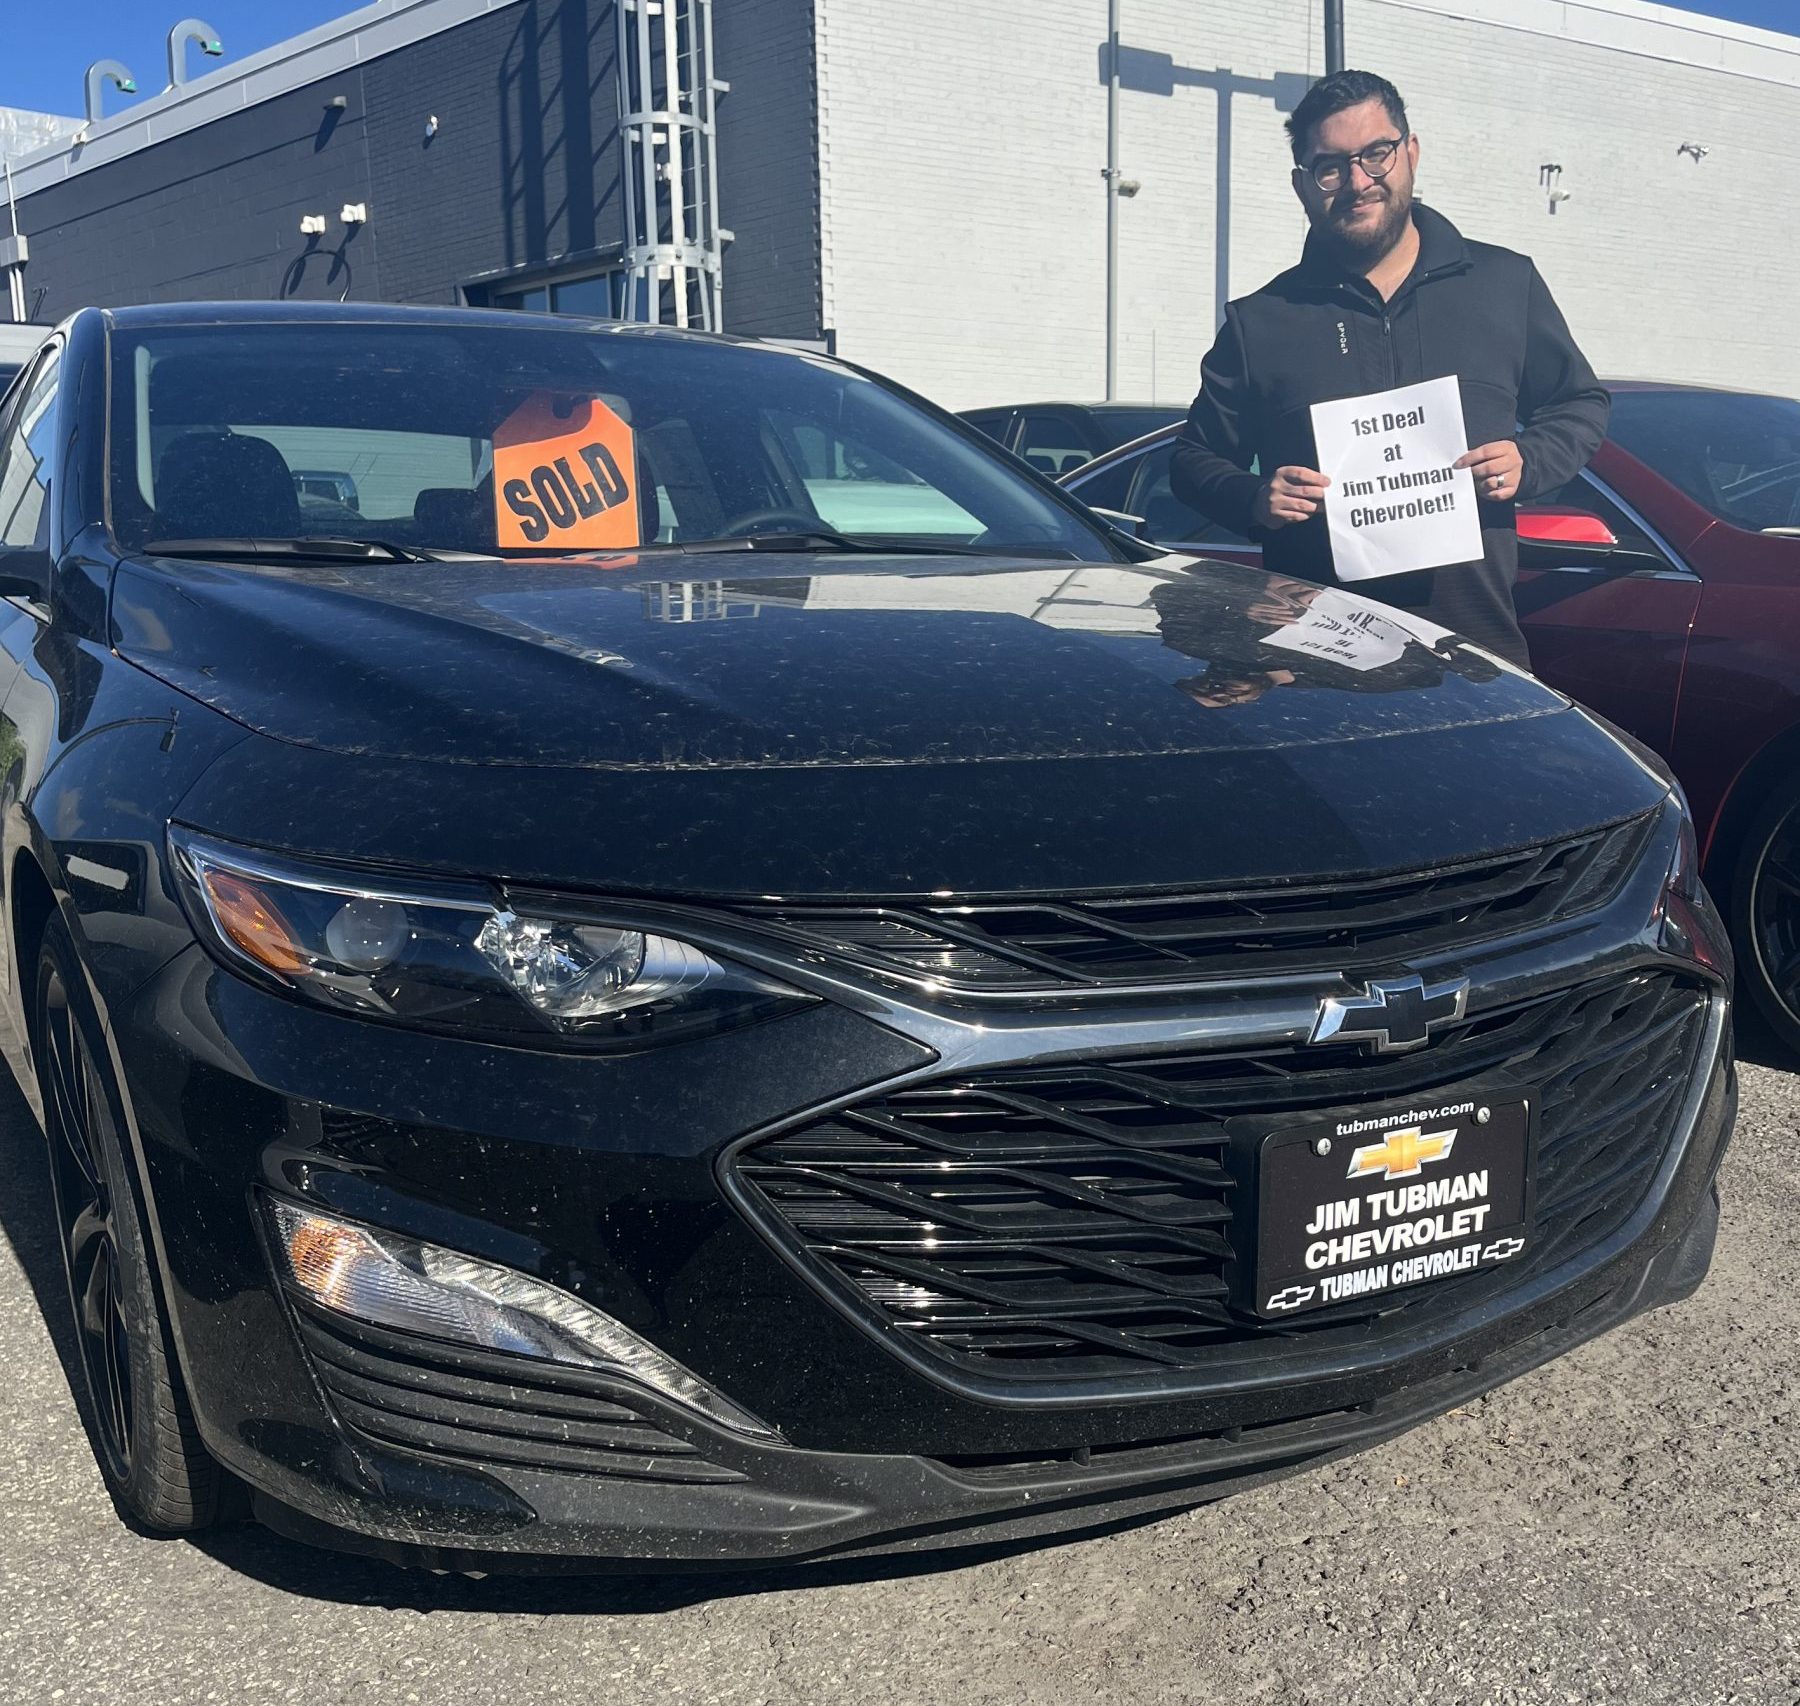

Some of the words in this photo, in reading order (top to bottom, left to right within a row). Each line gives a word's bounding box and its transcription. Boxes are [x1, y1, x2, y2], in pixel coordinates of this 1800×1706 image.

[1351, 417, 1380, 436] 1st
[1382, 406, 1425, 432] Deal
[1383, 444, 1403, 463] at
[503, 442, 629, 542] SOLD
[1342, 480, 1374, 498] Jim
[1376, 465, 1454, 492] Tubman
[1350, 492, 1456, 528] Chevrolet!!
[1336, 1102, 1475, 1136] tubmanchev.com
[1305, 1198, 1360, 1235] JIM
[1367, 1169, 1489, 1221] TUBMAN
[1304, 1204, 1491, 1270] CHEVROLET
[1320, 1264, 1389, 1302] TUBMAN
[1391, 1243, 1482, 1285] CHEVROLET
